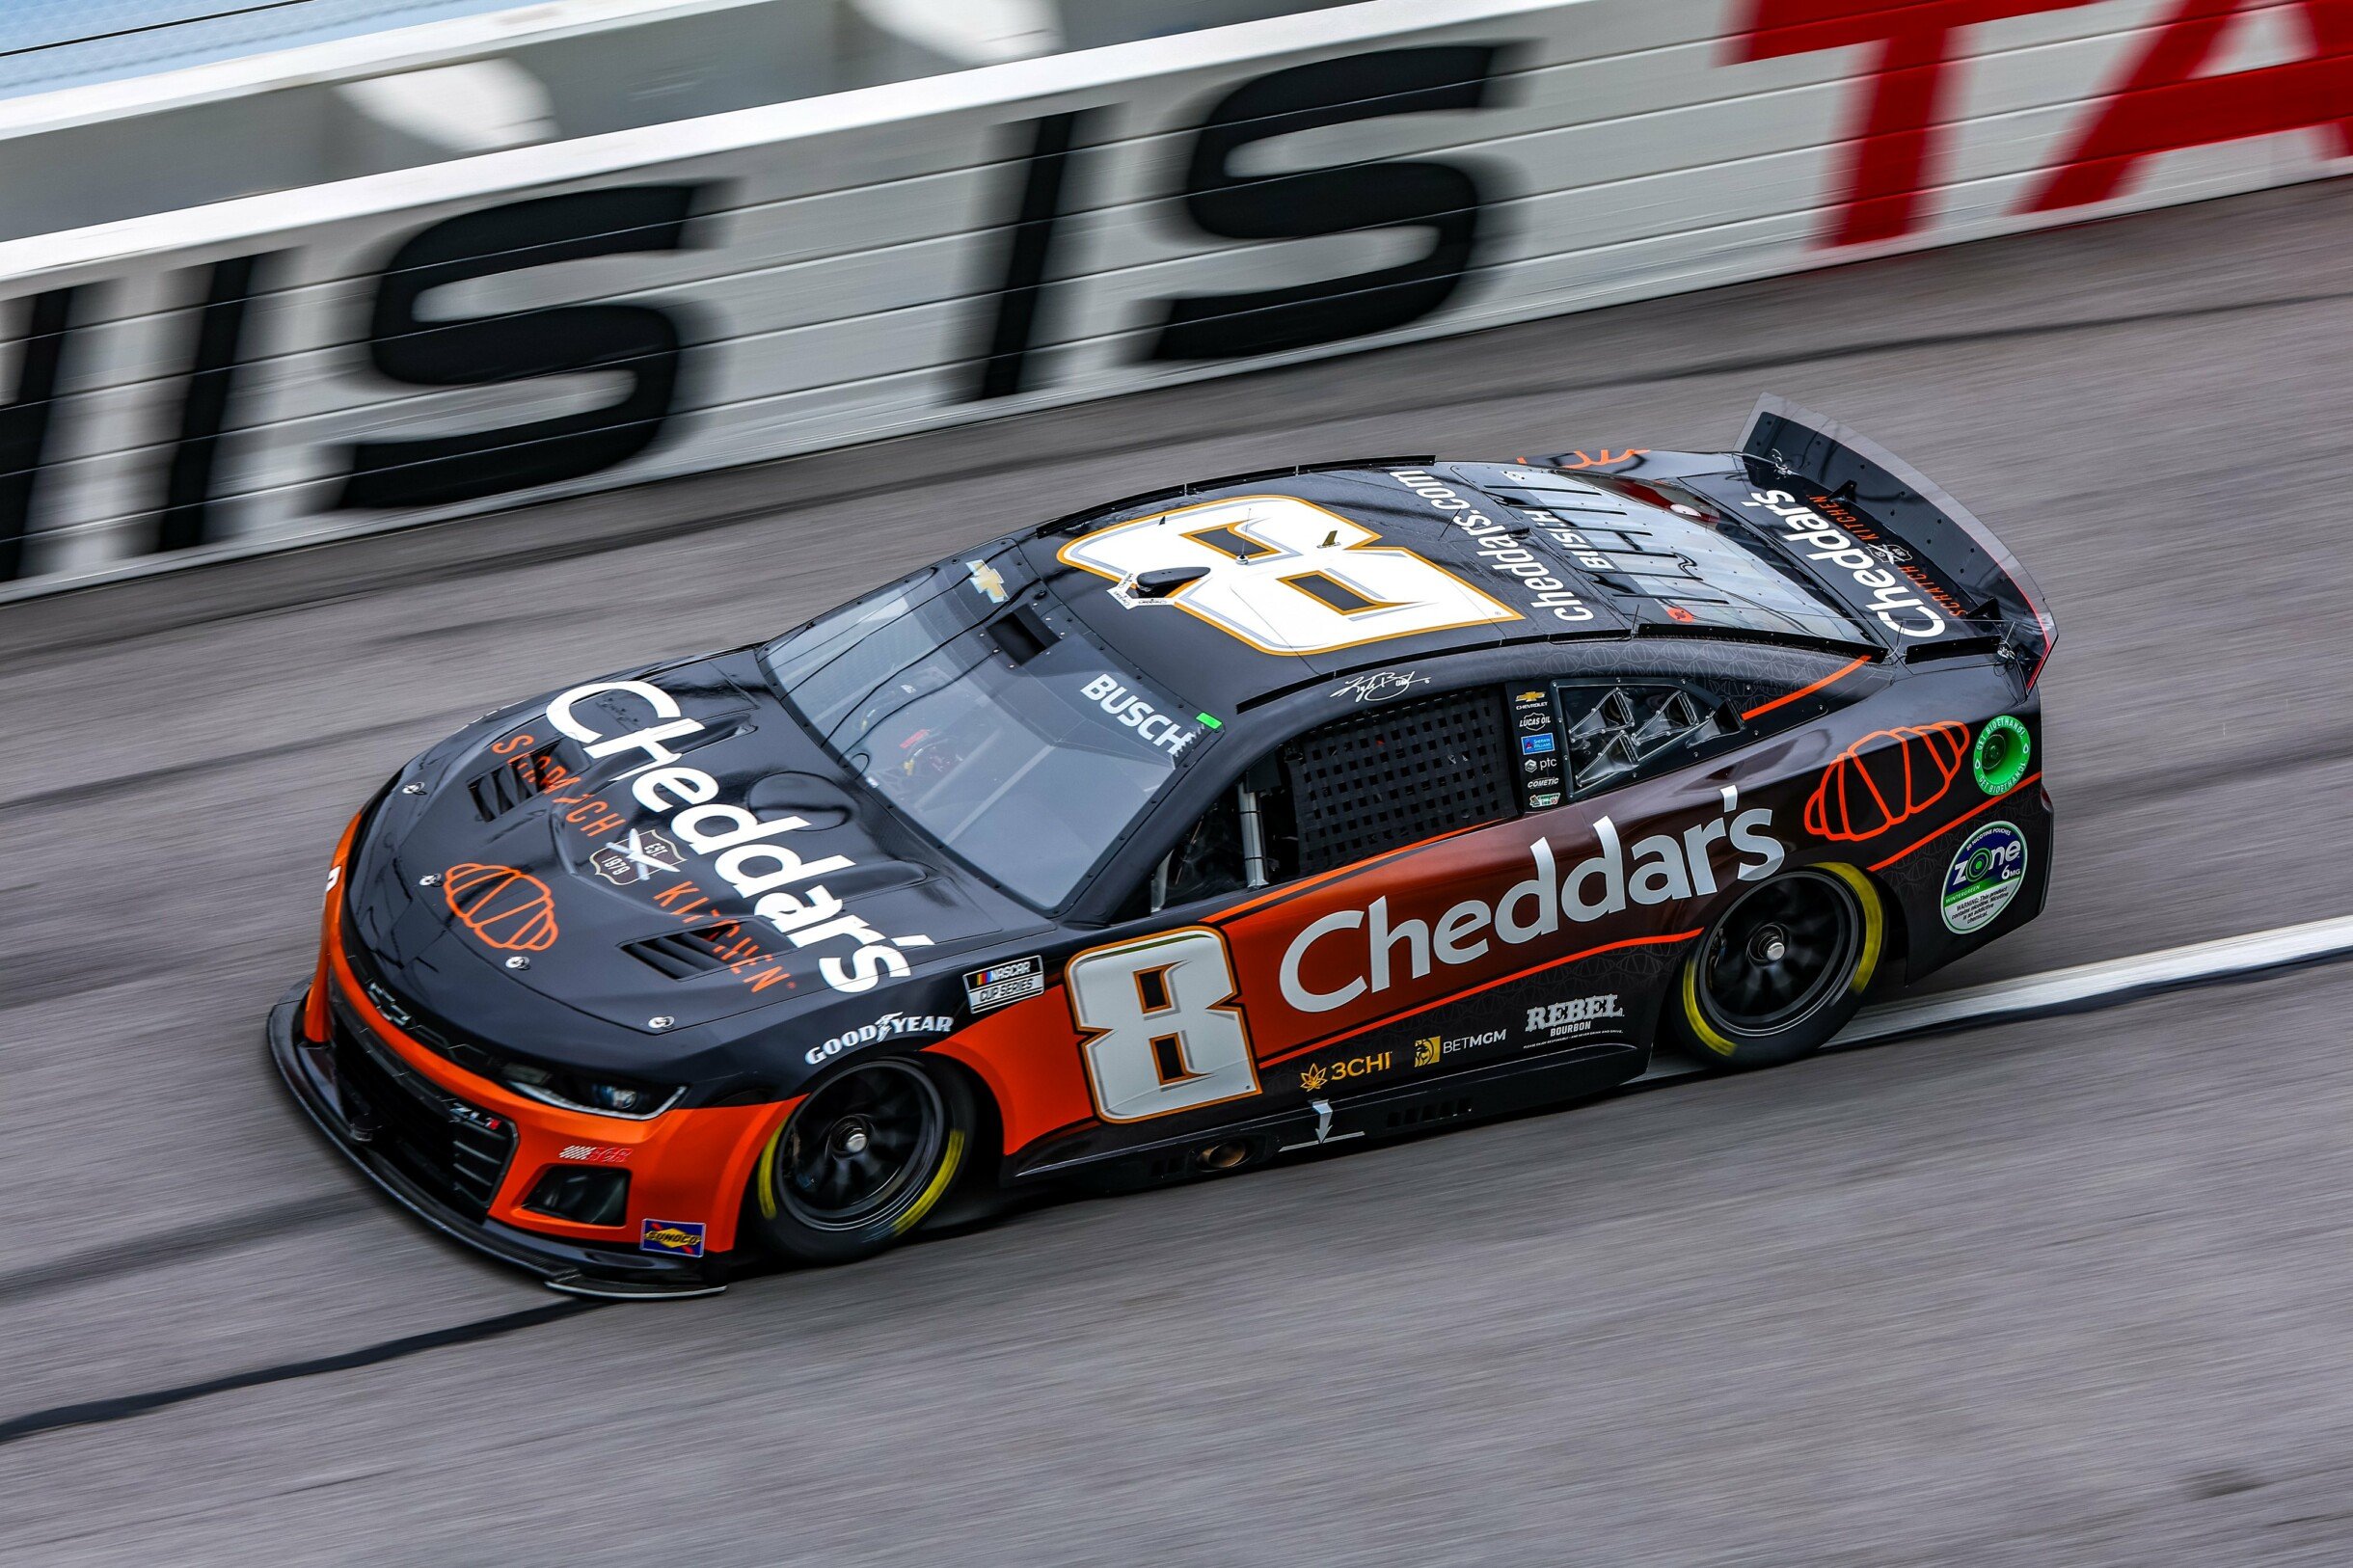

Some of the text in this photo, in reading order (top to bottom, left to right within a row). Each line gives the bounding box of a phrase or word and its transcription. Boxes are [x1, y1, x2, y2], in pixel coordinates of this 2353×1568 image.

[933, 39, 1545, 406] IS
[1390, 471, 1594, 622] cheddars.com
[1808, 495, 1967, 617] SCRATCH KITCHEN
[1057, 494, 1526, 657] 8
[1741, 490, 1946, 638] Cheddar's
[1080, 674, 1196, 755] BUSCH
[1516, 701, 1549, 711] CHEVROLET
[1519, 716, 1552, 728] LUCAS OIL
[1976, 735, 1987, 750] GET
[1539, 757, 1557, 770] ptc
[1528, 777, 1559, 789] COMETIC
[1979, 774, 1989, 789] GET
[545, 680, 936, 994] Cheddar's
[1279, 784, 1785, 1013] Cheddar's
[1945, 884, 1981, 904] WINTERGREEN
[989, 960, 1031, 981] NASCAR
[979, 979, 1034, 1003] CUP SERIES
[1065, 925, 1262, 1123] 8
[1525, 993, 1624, 1033] REBEL
[804, 1013, 955, 1066] GOODYEAR
[1443, 1029, 1507, 1054] BETMGM
[1550, 1021, 1591, 1037] BOURBON
[1331, 1051, 1392, 1081] 3CHI
[645, 1230, 701, 1246] SUNOCO
